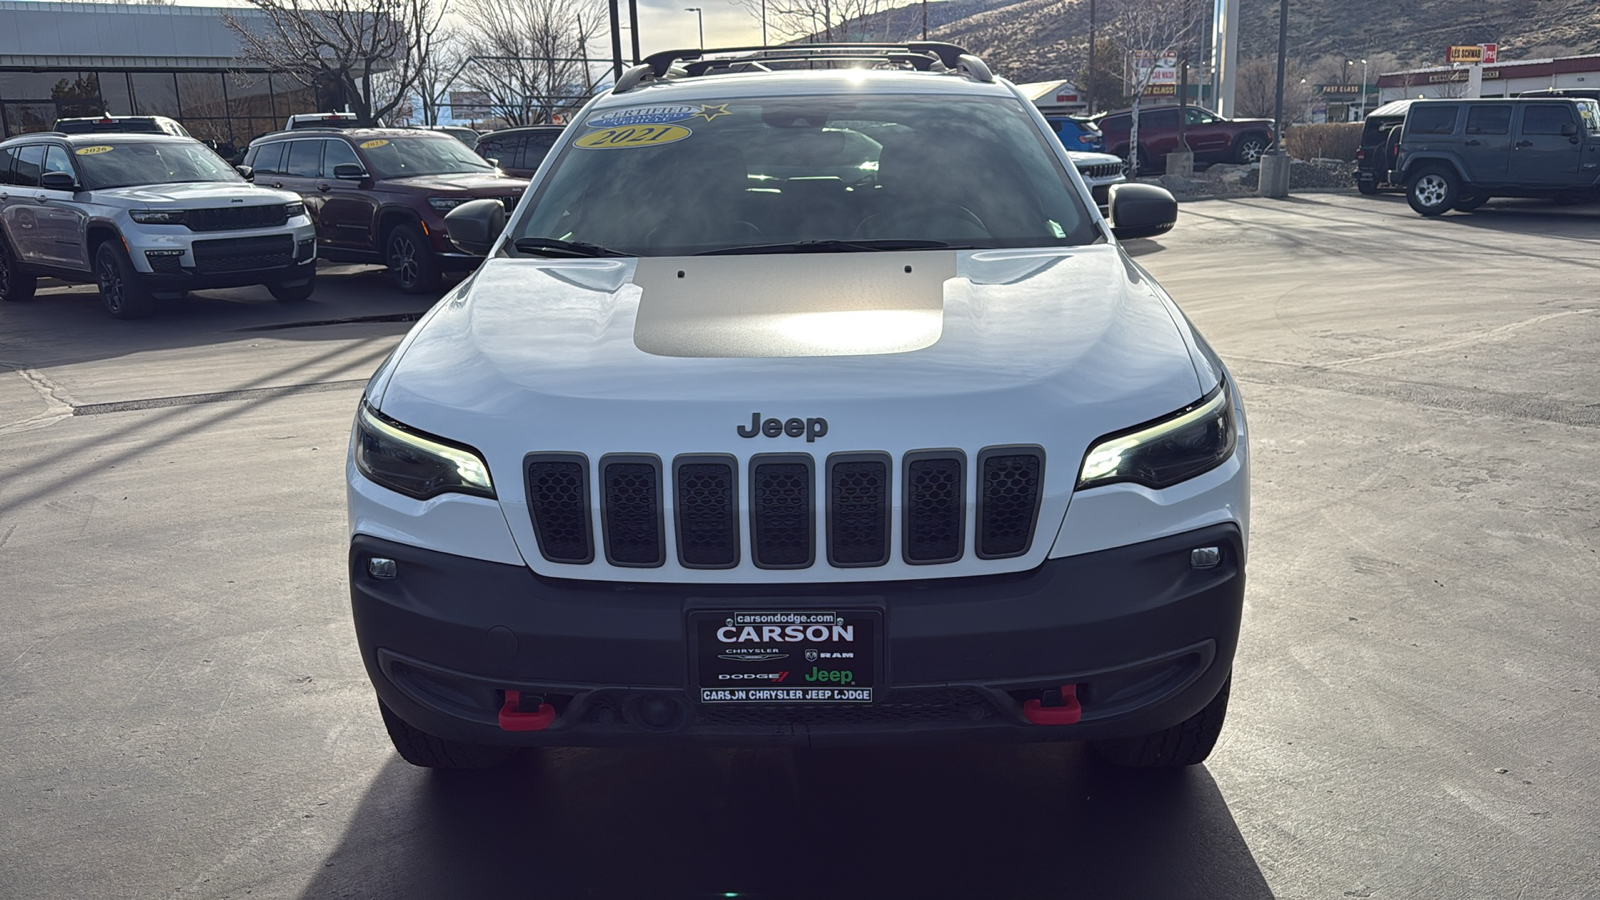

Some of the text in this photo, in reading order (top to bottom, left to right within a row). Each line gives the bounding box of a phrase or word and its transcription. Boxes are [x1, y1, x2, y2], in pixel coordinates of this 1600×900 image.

[1451, 48, 1481, 59] LES SCHWAB
[1153, 86, 1174, 94] CLASS
[601, 106, 692, 120] CERTIFIED
[613, 117, 670, 126] VEHICLE
[589, 126, 674, 146] 2021
[736, 412, 828, 443] Jeep
[737, 613, 834, 624] carsondodge.com
[716, 625, 854, 643] CARSON
[805, 666, 853, 685] Jeep
[748, 690, 803, 700] CHRYSLER
[805, 689, 832, 700] JEEP
